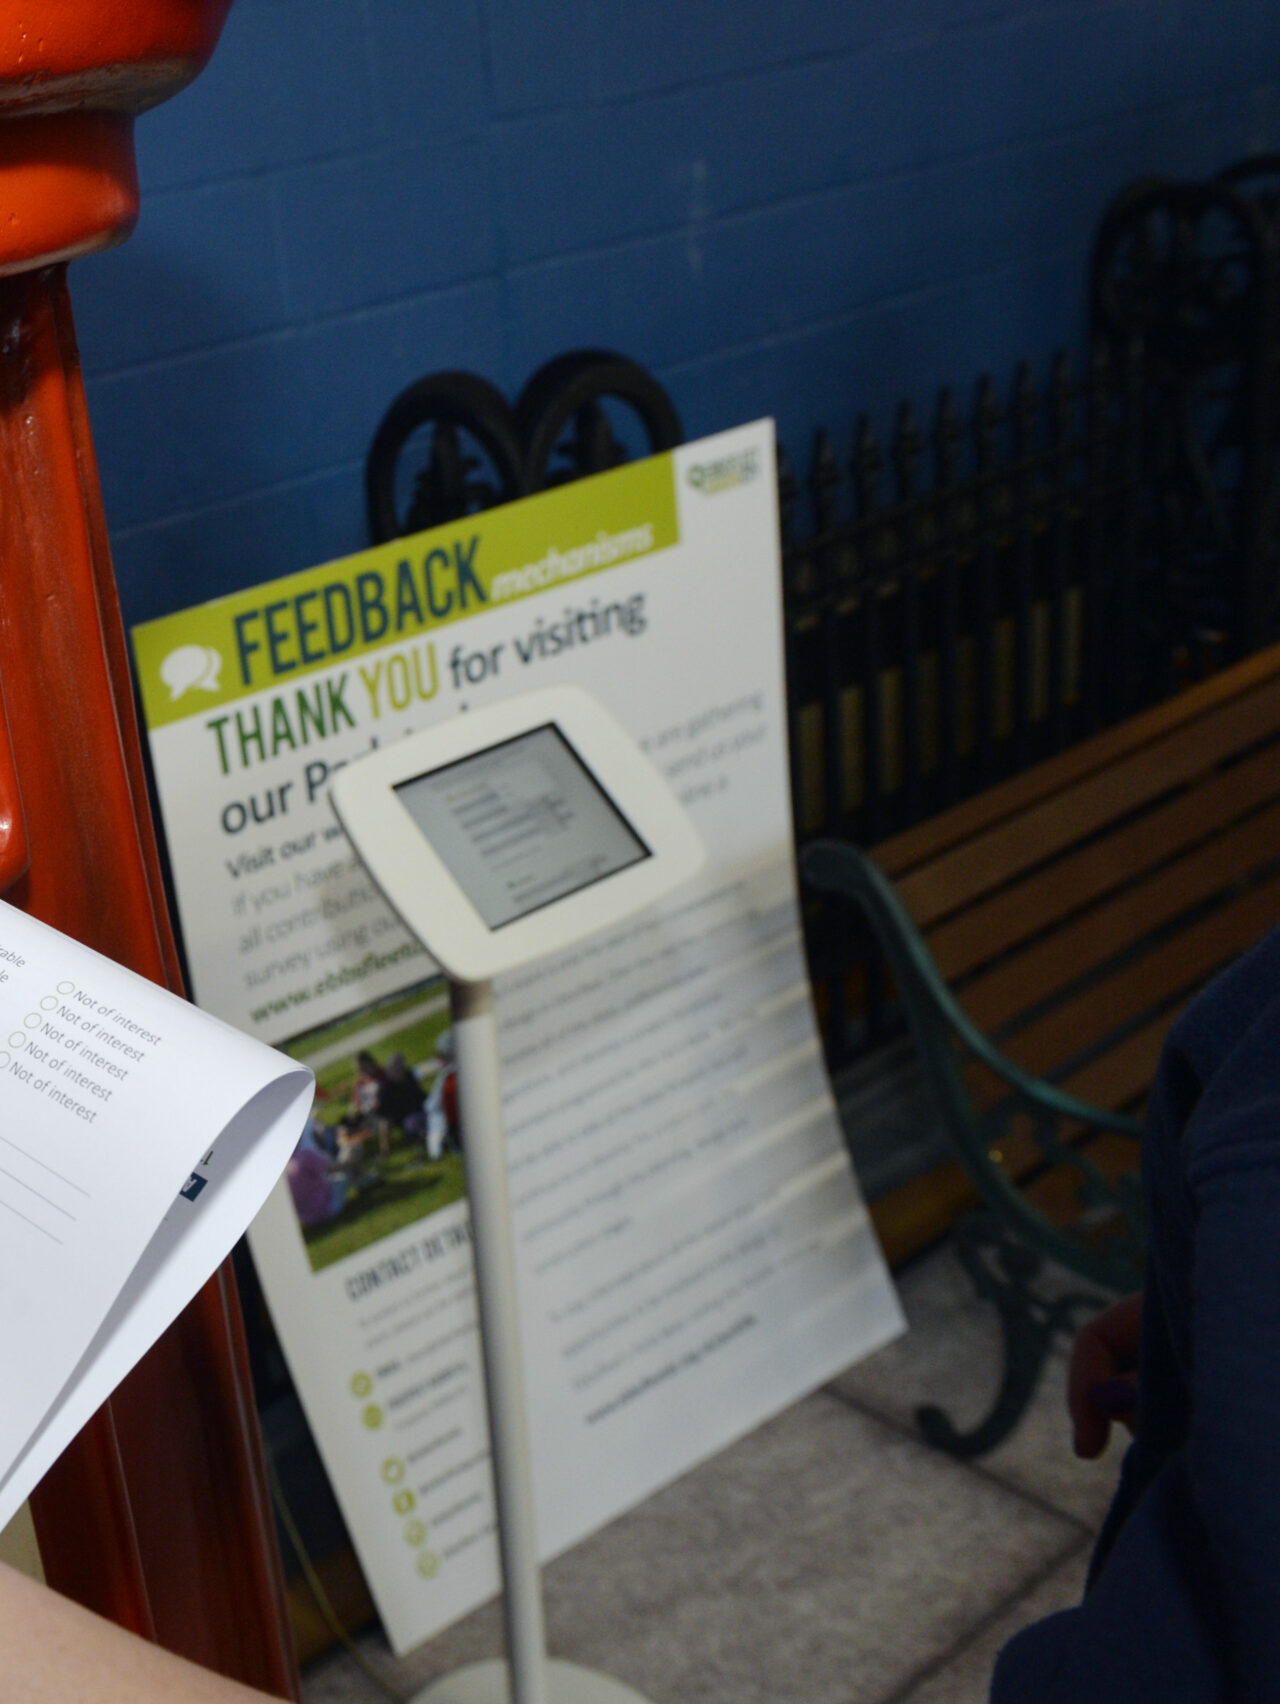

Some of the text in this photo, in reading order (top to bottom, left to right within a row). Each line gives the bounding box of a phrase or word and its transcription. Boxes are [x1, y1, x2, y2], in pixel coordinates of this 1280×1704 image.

[233, 522, 655, 686] FEEDBACK mechanisms
[206, 671, 356, 775] THANK
[358, 641, 441, 719] YOU
[449, 640, 506, 689] for
[513, 591, 649, 667] visiting
[221, 780, 295, 836] our
[224, 838, 275, 879] Visit
[280, 830, 317, 860] our
[56, 1005, 145, 1063] Not of interest
[73, 990, 162, 1046] Not of interest
[24, 1041, 113, 1102] Not of interest
[40, 1022, 129, 1082] Not of interest
[9, 1061, 98, 1124] Not of interest
